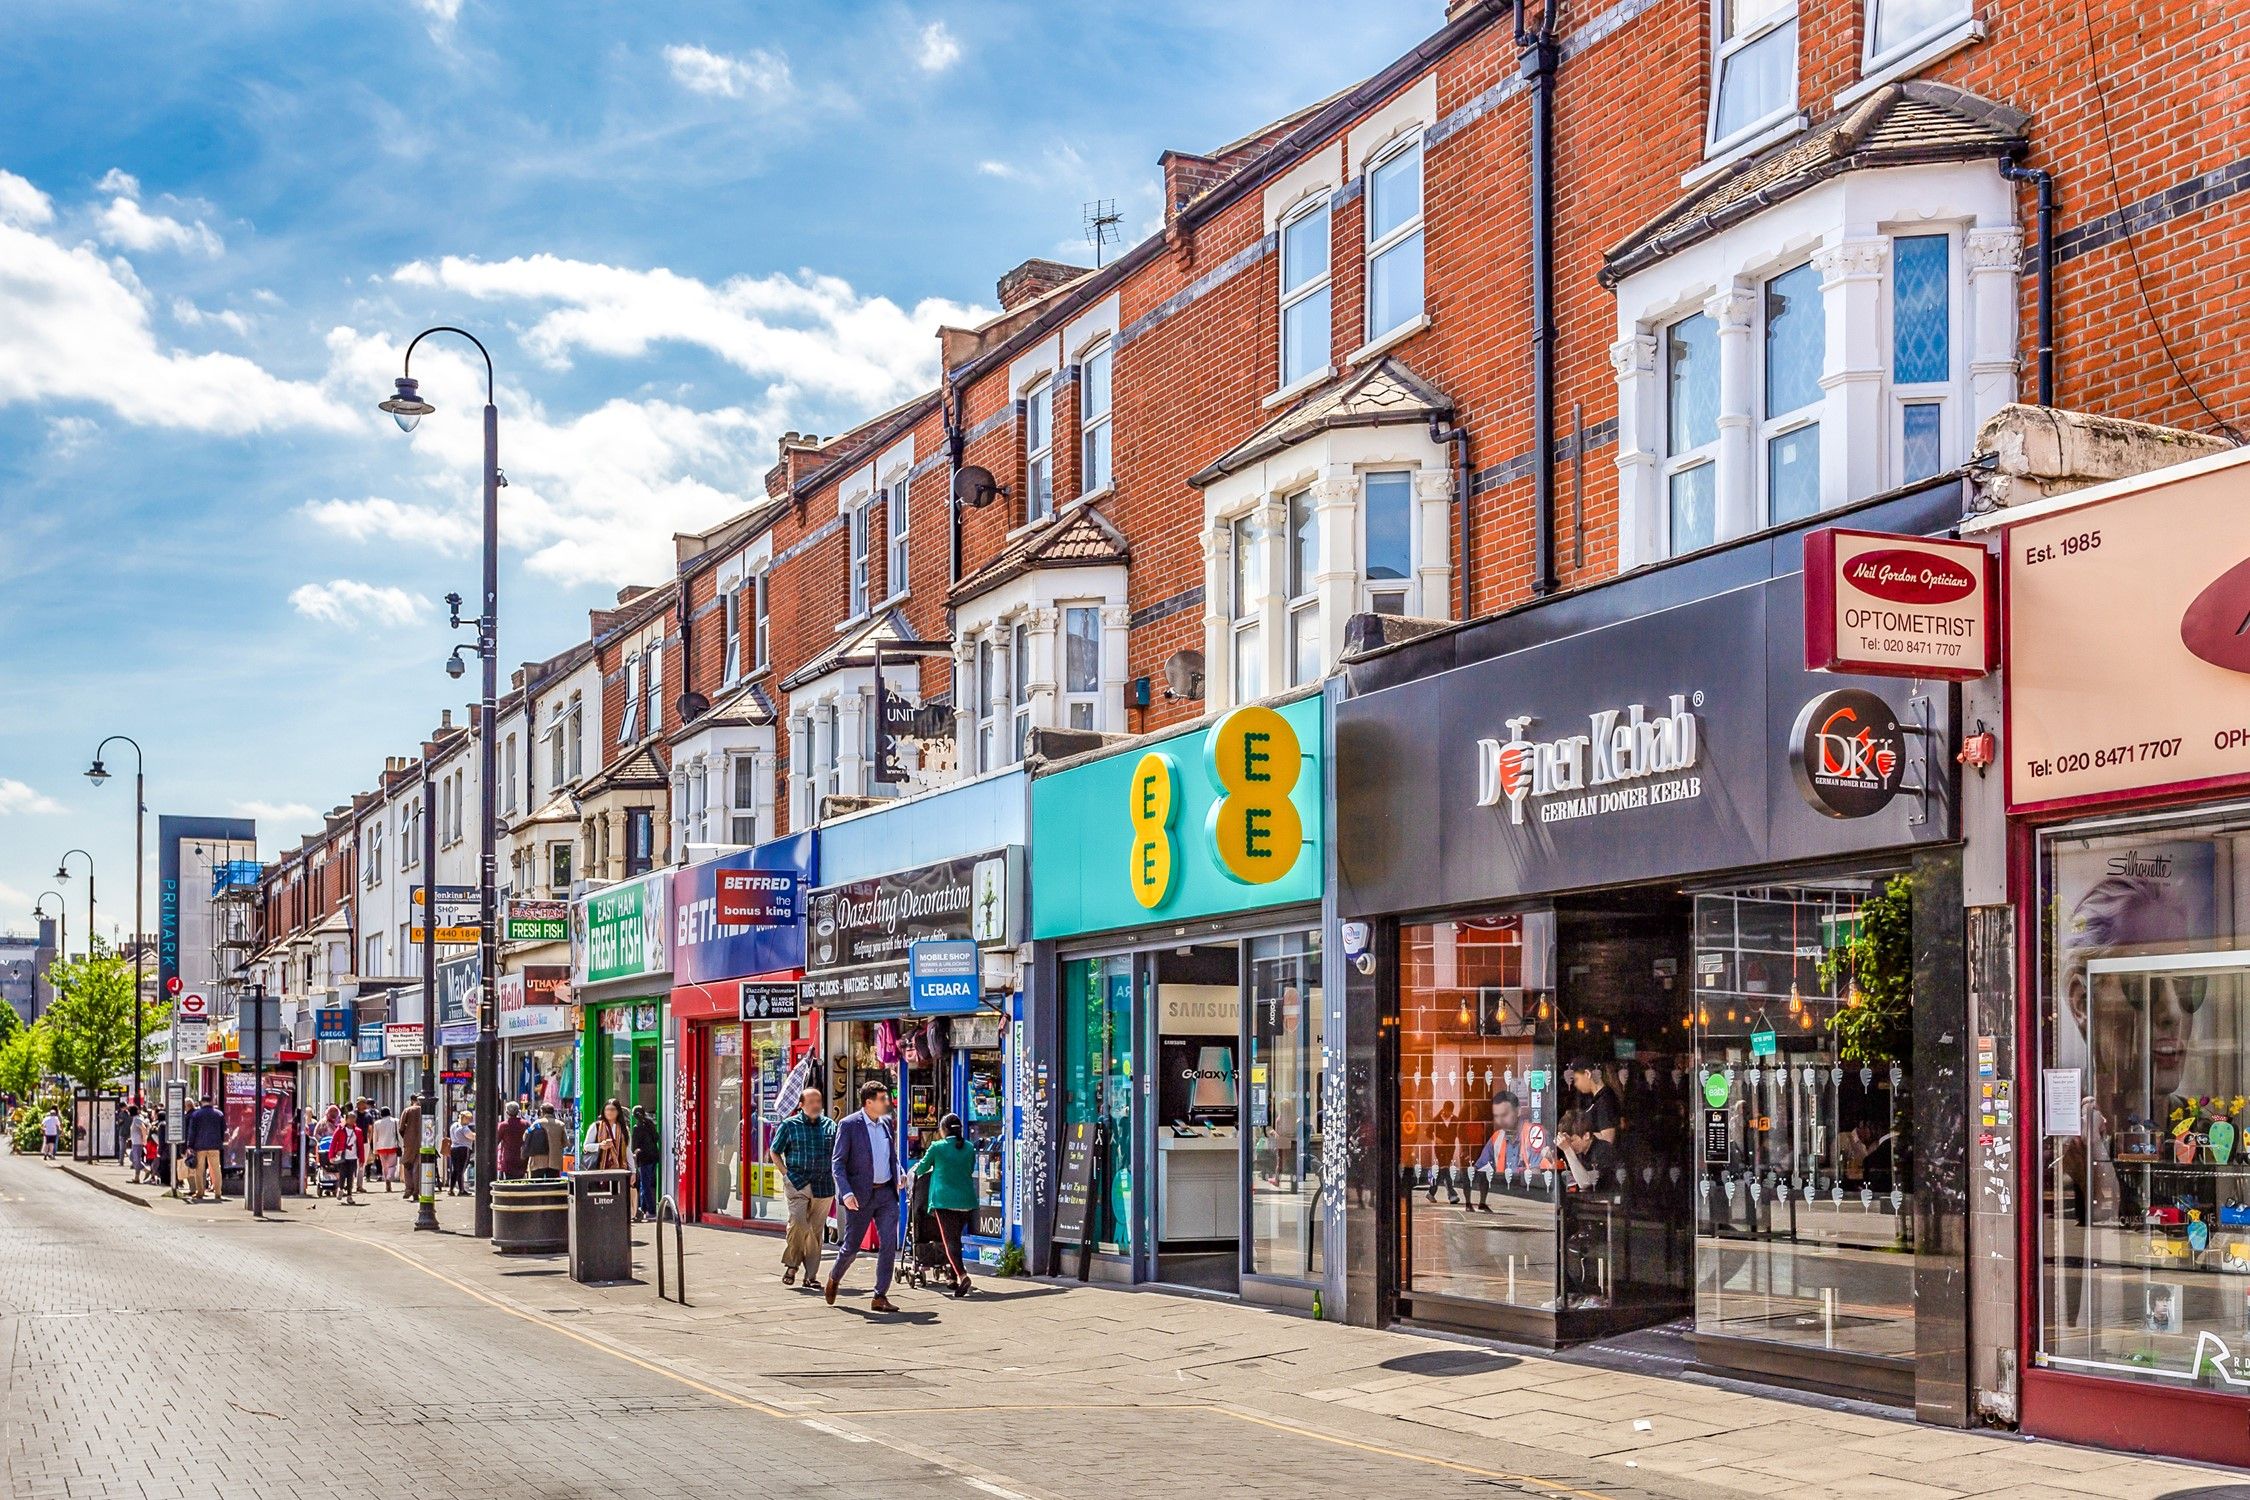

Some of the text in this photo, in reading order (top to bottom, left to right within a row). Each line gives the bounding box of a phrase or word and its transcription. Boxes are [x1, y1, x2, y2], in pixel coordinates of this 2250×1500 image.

[2026, 530, 2102, 566] Est. 1985
[1853, 562, 1968, 590] Neil Gordon Opticians
[1845, 608, 1975, 637] OPTOMETRIST
[1860, 636, 1962, 656] Tel: 020 8471 7707
[887, 708, 915, 722] UNIT
[1588, 694, 1697, 786] Kebab
[2027, 737, 2183, 778] Tel: 020 8471 7707
[1815, 776, 1879, 790] GERMAN DONER KEBAB
[1541, 777, 1701, 823] GERMAN DONER KEBAB
[2106, 850, 2172, 878] Silhouette
[724, 877, 791, 890] BETFRED
[597, 892, 635, 923] EAST HAM
[776, 896, 791, 906] the
[838, 878, 971, 934] Dazzling Decoration
[511, 907, 565, 919] EAST HAM
[724, 906, 791, 918] bonus king
[162, 879, 176, 966] PRIMARK
[512, 922, 564, 938] FRESH FISH
[677, 897, 750, 947] BETF
[461, 929, 481, 938] 1840
[590, 916, 641, 972] FRESH FISH
[919, 952, 971, 961] MOBILE SHOP
[172, 980, 179, 991] J
[447, 962, 478, 1003] MaxCe
[745, 986, 770, 995] Dazzling
[801, 982, 816, 998] RUGS
[819, 979, 840, 997] CLOCKS
[843, 975, 870, 994] WATCHES
[873, 972, 898, 991] ISLAMIC
[921, 982, 971, 997] LEBARA
[500, 982, 522, 1013] Hello
[1168, 1001, 1240, 1018] SAMSUN
[1268, 998, 1277, 1027] Galaxy
[320, 1030, 347, 1038] GREGGS
[388, 1026, 410, 1034] Mobile
[1181, 1068, 1229, 1082] Galaxy
[1708, 1087, 1726, 1097] eats
[593, 1197, 614, 1205] Litter
